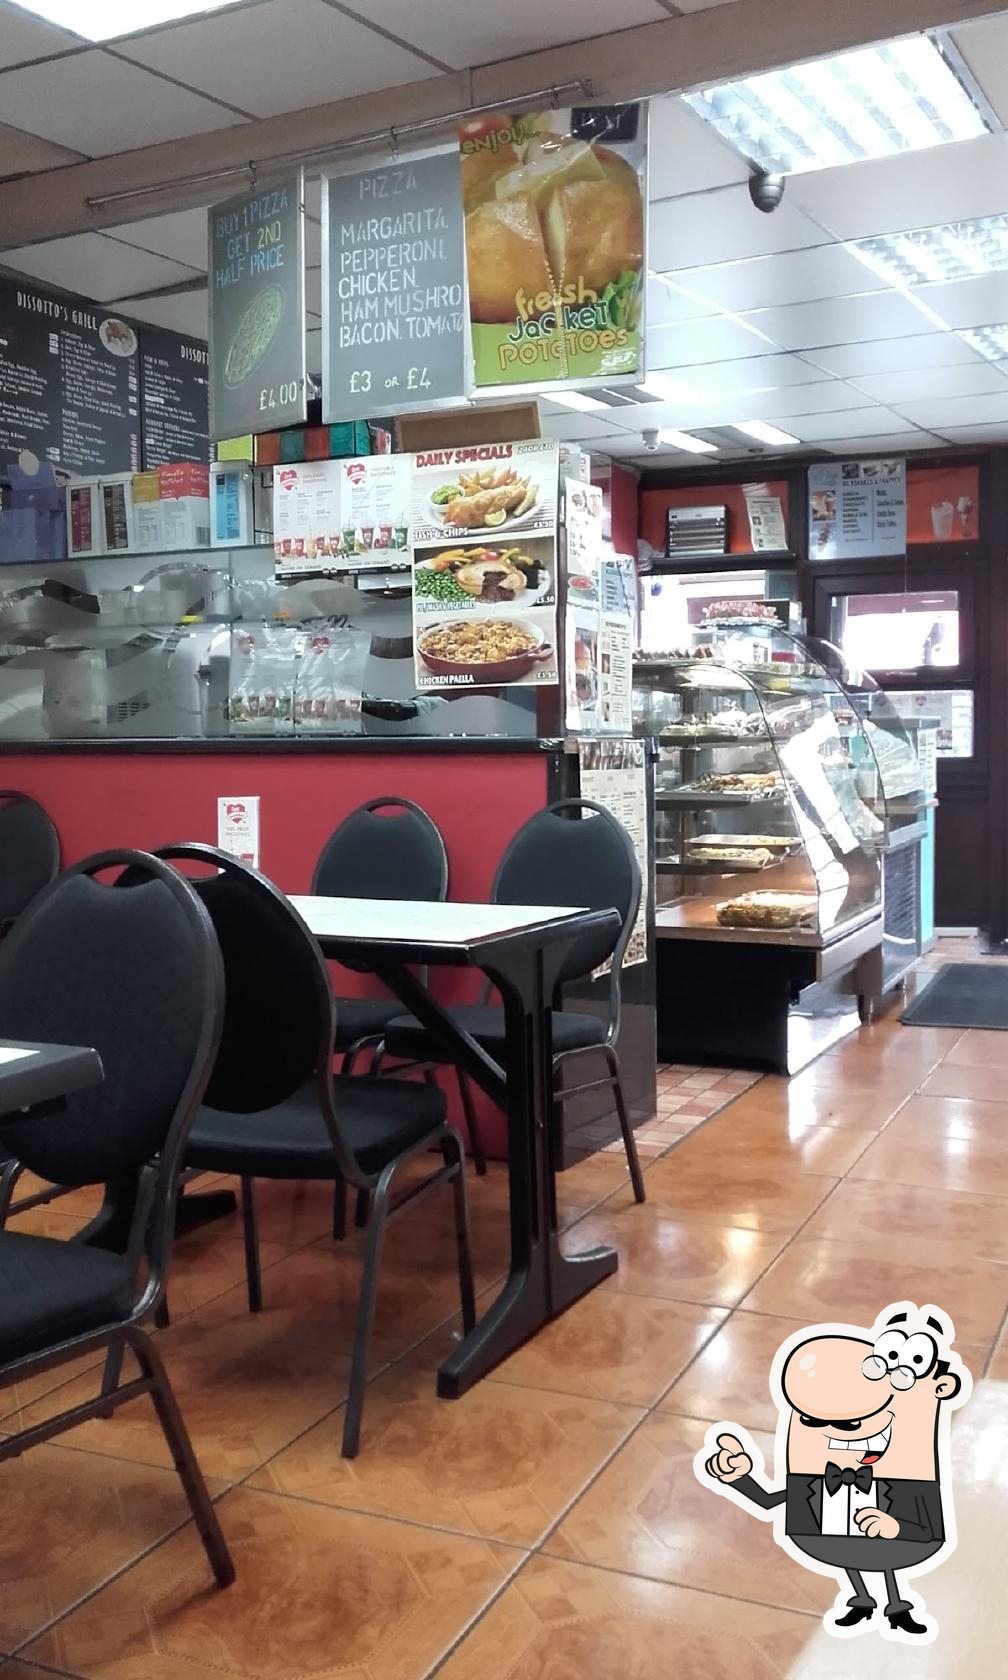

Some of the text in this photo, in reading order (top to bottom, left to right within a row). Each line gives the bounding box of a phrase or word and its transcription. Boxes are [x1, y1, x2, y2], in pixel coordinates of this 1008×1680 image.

[359, 170, 418, 200] PIZZA
[216, 189, 288, 238] BUY 1 PIZZA
[227, 220, 281, 260] GET 2ND
[215, 244, 284, 288] HALF PRICE
[16, 291, 98, 331] DISSOTTO'S GRILL
[341, 284, 462, 323] HAM MUSHRO
[515, 275, 598, 320] fresh
[259, 381, 298, 411] £4.00
[350, 370, 371, 393] £3
[407, 367, 431, 390] £4
[416, 444, 513, 469] DAILY SPECIALS
[412, 529, 433, 542] FISH
[443, 527, 469, 538] CHIPS
[420, 673, 475, 685] CHICKEN PAELLA
